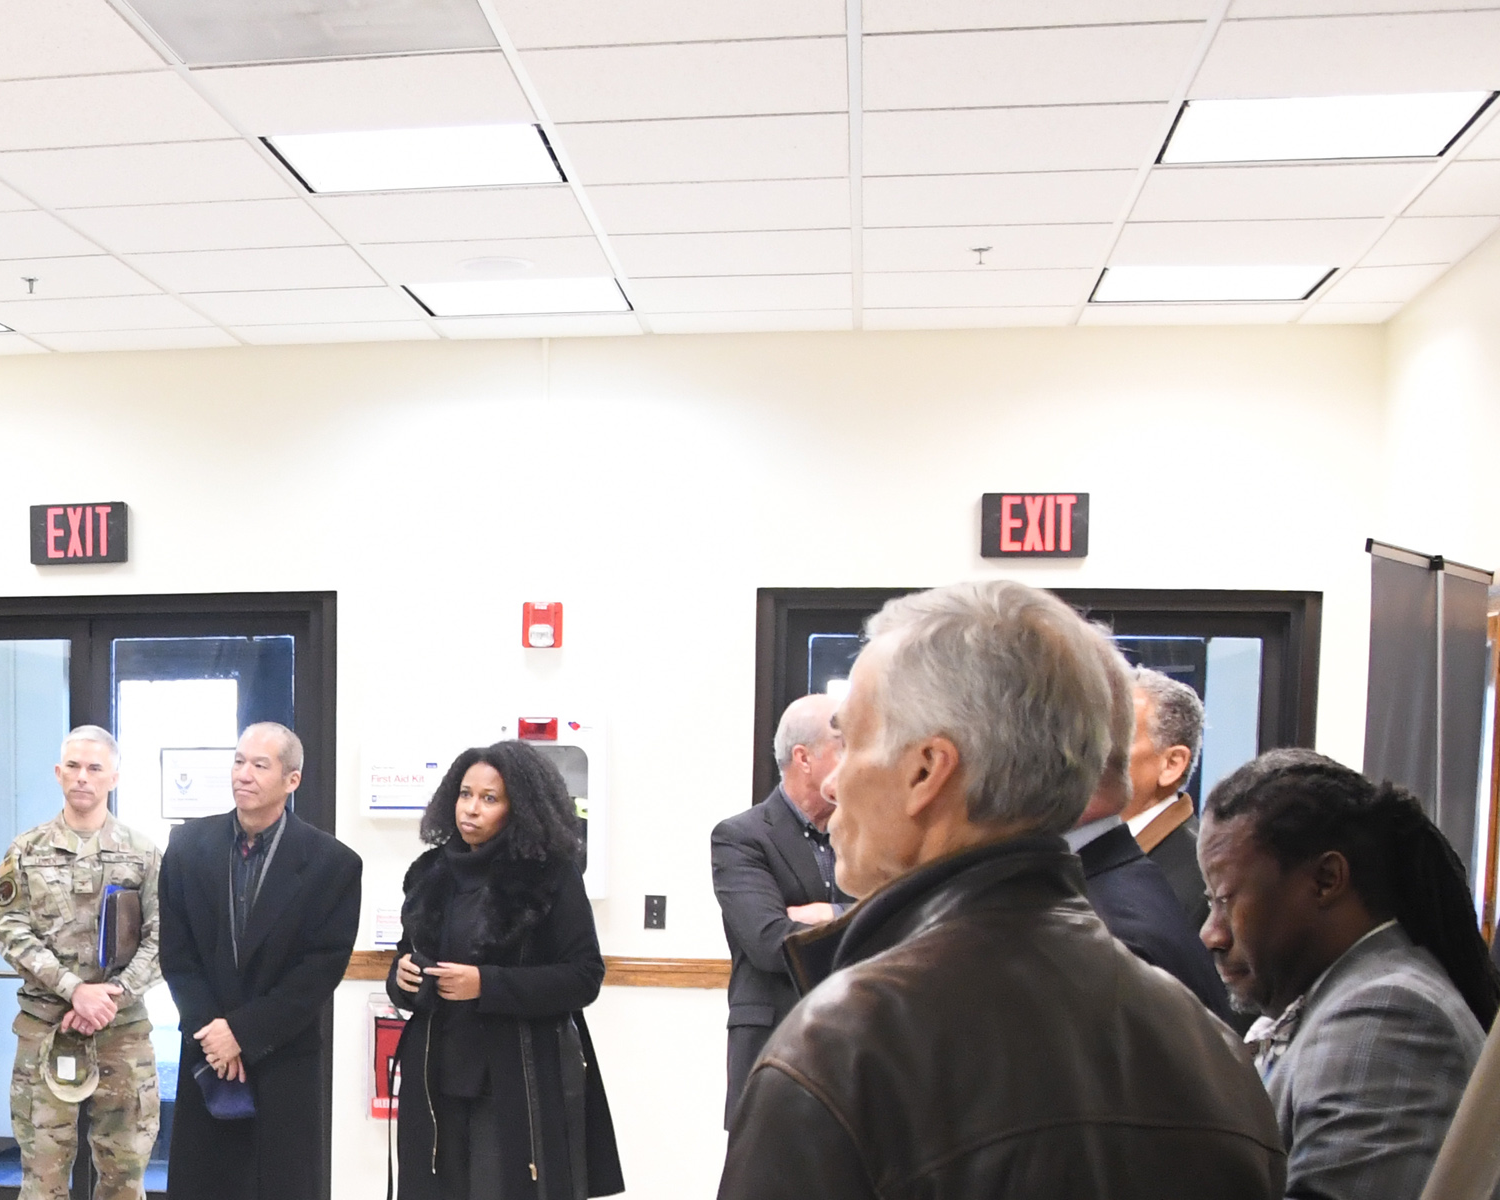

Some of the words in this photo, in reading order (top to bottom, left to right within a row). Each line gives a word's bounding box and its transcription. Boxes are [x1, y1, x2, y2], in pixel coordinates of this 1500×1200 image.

[46, 505, 112, 559] EXIT
[1000, 495, 1077, 552] EXIT
[371, 774, 391, 783] First
[394, 774, 409, 783] Aid
[412, 774, 425, 783] Kit
